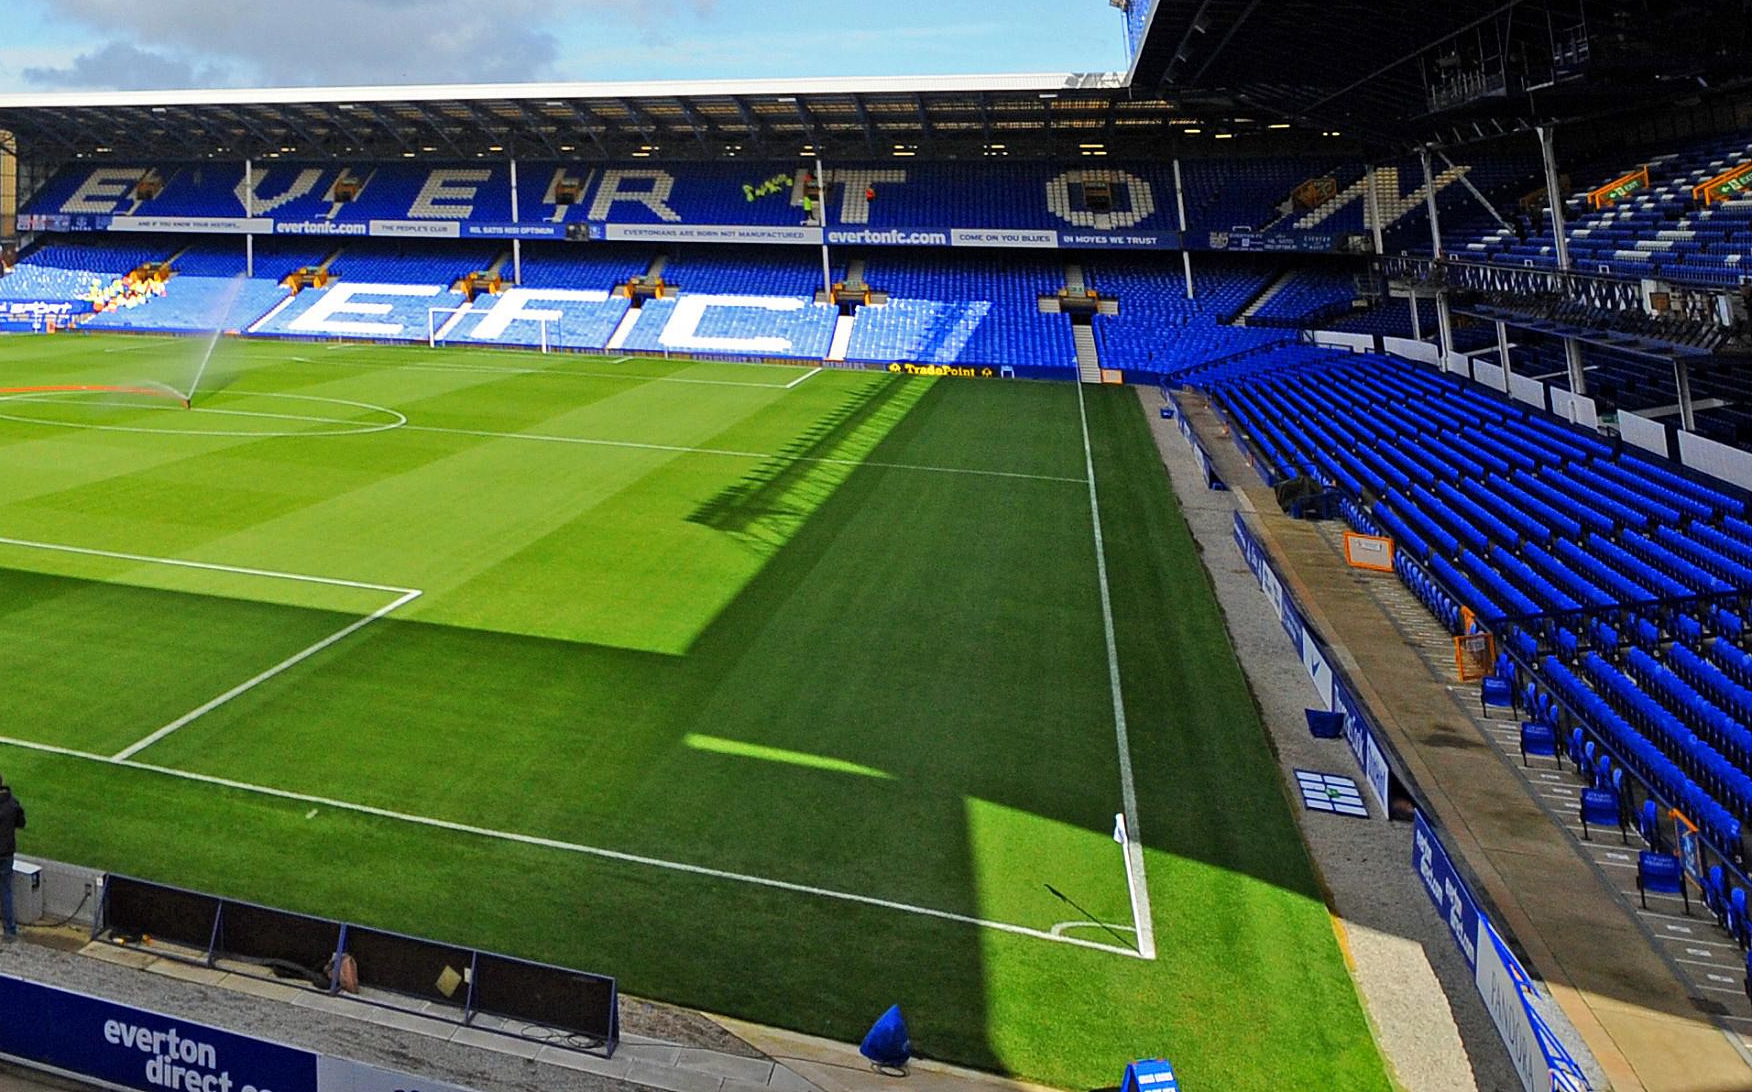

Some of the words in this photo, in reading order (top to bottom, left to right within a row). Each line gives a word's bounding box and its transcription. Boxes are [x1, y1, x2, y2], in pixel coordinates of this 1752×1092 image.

[277, 220, 366, 235] evertonfc.com
[623, 229, 677, 237] EVERTONIANS
[738, 231, 805, 239] MANUFACTURED
[828, 229, 946, 245] evertonfc.com
[1063, 235, 1074, 243] IN
[1075, 236, 1109, 244] MOYES
[1110, 236, 1124, 244] WE
[1126, 237, 1158, 245] TRUST
[904, 363, 976, 377] TradePoint
[104, 1018, 217, 1070] everton
